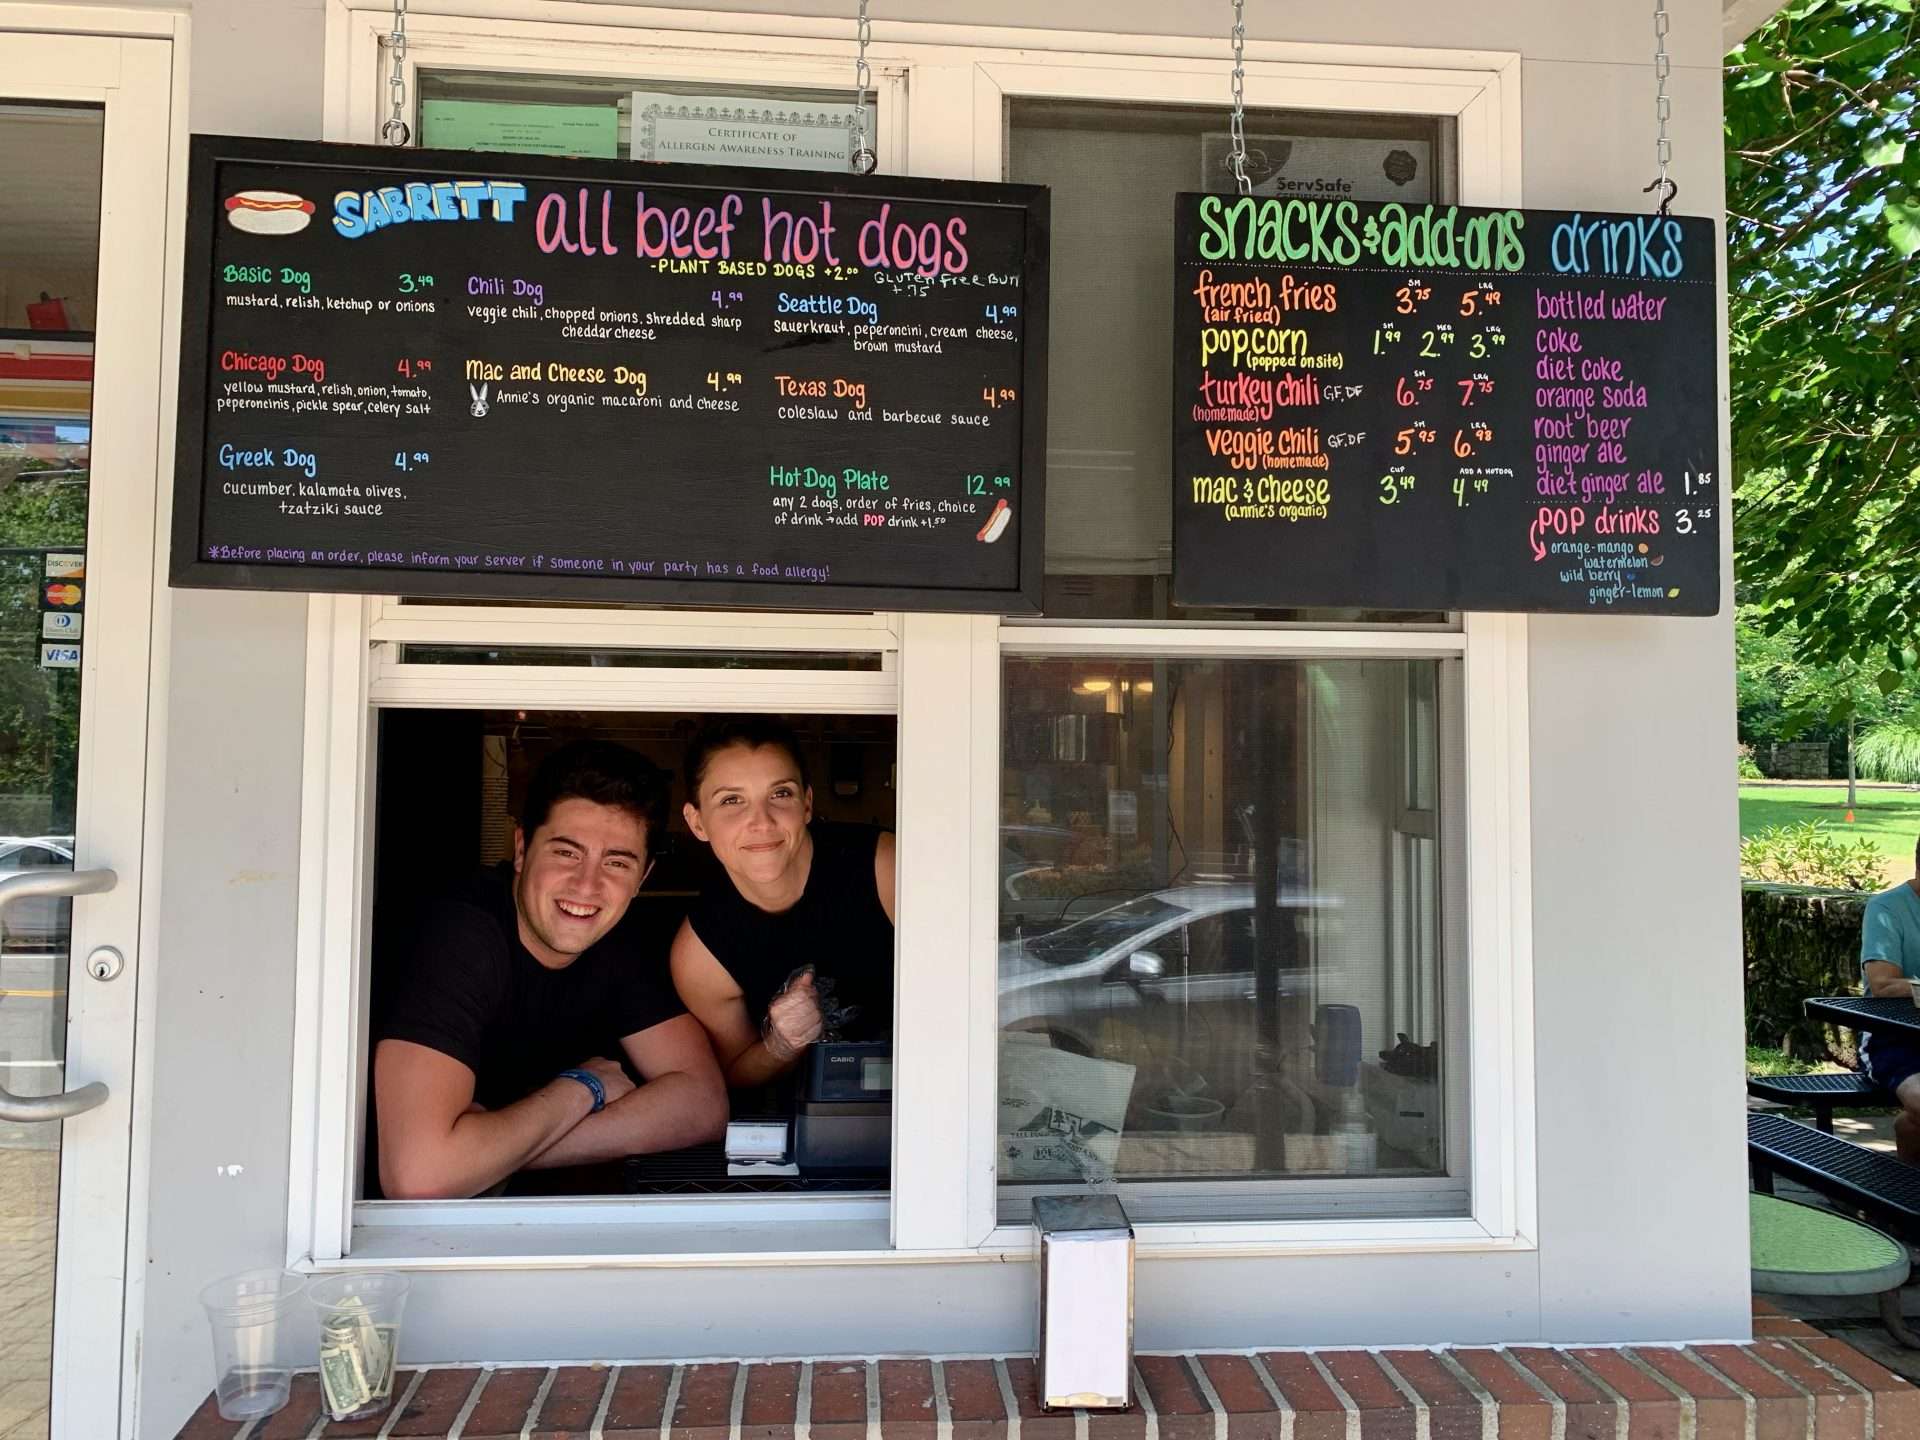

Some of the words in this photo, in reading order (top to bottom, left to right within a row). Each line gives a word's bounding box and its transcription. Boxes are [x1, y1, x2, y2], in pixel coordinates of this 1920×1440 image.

[1278, 177, 1352, 192] ServSafe
[333, 181, 526, 238] SABRETT
[536, 189, 617, 255] all
[637, 192, 742, 259] beef
[762, 198, 839, 266] hot
[857, 203, 969, 277] dogs
[1552, 214, 1683, 277] drinks
[224, 265, 271, 283] Basic
[281, 268, 310, 293] Dog
[718, 261, 766, 275] BASED
[773, 264, 814, 279] DOGS
[399, 274, 433, 292] 3.49
[468, 276, 504, 294] Chili
[513, 280, 543, 305] Dog
[1193, 270, 1271, 308] french
[1280, 275, 1336, 312] fries
[1479, 282, 1493, 290] LRG
[327, 300, 372, 314] ketchup
[396, 301, 435, 312] onions
[712, 291, 742, 308] 4.99
[778, 293, 842, 314] Seattle
[847, 297, 877, 324] Dog
[1396, 288, 1431, 313] 3.75
[1460, 291, 1500, 316] 5.49
[1537, 288, 1605, 319] bottled
[1612, 291, 1666, 320] water
[468, 306, 507, 324] veggie
[545, 307, 595, 323] chopped
[647, 312, 705, 326] shredded
[712, 315, 741, 331] sharp
[986, 305, 1016, 323] 4.99
[1204, 306, 1230, 323] (air
[1234, 305, 1280, 326] fried)
[562, 324, 612, 338] cheddar
[615, 325, 656, 340] cheese
[931, 327, 967, 337] cream
[1374, 330, 1400, 354] 1.99
[1420, 331, 1454, 357] 2.99
[854, 340, 887, 352] brown
[895, 341, 942, 353] mustard
[1202, 328, 1308, 367] popcorn
[1470, 334, 1505, 358] 3.99
[222, 351, 286, 380] Chicago
[292, 355, 324, 382] Dog
[398, 359, 431, 378] 4.99
[467, 360, 503, 380] Mac
[510, 362, 541, 380] and
[548, 363, 606, 383] Cheese
[614, 367, 646, 396] Dog
[1536, 355, 1576, 381] diet
[224, 382, 263, 395] yellow
[708, 372, 741, 391] 4.99
[775, 376, 826, 397] Texas
[833, 379, 865, 408] Dog
[1397, 377, 1433, 406] 6.75
[1458, 380, 1494, 406] 7.75
[497, 390, 539, 404] Annie's
[547, 393, 594, 412] organic
[602, 392, 661, 407] macaroni
[670, 395, 693, 409] and
[697, 397, 739, 411] cheese
[984, 388, 1015, 408] 4.99
[1198, 370, 1272, 422] turkey
[1276, 373, 1319, 406] chili
[1536, 387, 1595, 419] orange
[1603, 380, 1647, 408] soda
[297, 400, 328, 413] pickle
[368, 401, 400, 417] celery
[406, 404, 431, 413] salt
[778, 405, 837, 419] coleslaw
[849, 407, 872, 420] and
[883, 409, 941, 423] barbecue
[951, 415, 990, 426] sauce
[1193, 404, 1260, 422] (homemade)
[1471, 422, 1487, 430] LRG
[1535, 413, 1576, 439] root
[1587, 413, 1631, 440] beer
[1279, 427, 1318, 455] chili
[1395, 429, 1436, 455] 5.95
[1454, 430, 1492, 458] 6.98
[220, 444, 274, 470] Greek
[283, 449, 316, 477] Dog
[395, 452, 428, 471] 4.99
[1262, 454, 1329, 471] (homemade)
[1536, 443, 1590, 475] ginger
[1598, 441, 1626, 463] ale
[299, 482, 361, 496] kalamata
[771, 466, 801, 487] Hot
[803, 468, 836, 499] Dog
[843, 469, 889, 490] Plate
[968, 475, 1010, 495] 12.99
[1193, 477, 1238, 503] mac
[1258, 475, 1330, 505] cheese
[1380, 476, 1415, 504] 3.49
[1453, 479, 1488, 506] 4.49
[1536, 470, 1576, 496] diet
[1582, 473, 1630, 504] ginger
[1637, 470, 1664, 494] ale
[1685, 472, 1711, 495] 1.85
[279, 501, 338, 514] tzatziki
[344, 504, 383, 515] sauce
[847, 496, 878, 509] order
[938, 500, 976, 513] choice
[1225, 504, 1275, 521] (annie's
[1279, 505, 1327, 522] organic)
[791, 512, 823, 525] drink
[864, 514, 885, 526] POP
[888, 515, 918, 527] drink
[1595, 506, 1659, 534] drinks
[1675, 509, 1711, 533] 3.25
[1551, 542, 1634, 560] orange-mango
[1584, 556, 1648, 568] watermelon
[267, 548, 305, 562] placing
[368, 551, 403, 564] please
[412, 552, 449, 565] inform
[454, 556, 478, 570] your
[485, 556, 525, 566] server
[551, 558, 603, 570] someone
[629, 561, 654, 574] your
[664, 561, 697, 576] party
[752, 563, 779, 575] food
[785, 566, 829, 582] allergy!
[1560, 568, 1584, 582] wild
[1589, 570, 1620, 589] berry
[1590, 584, 1664, 604] ginger-lemon
[46, 650, 78, 660] VISA
